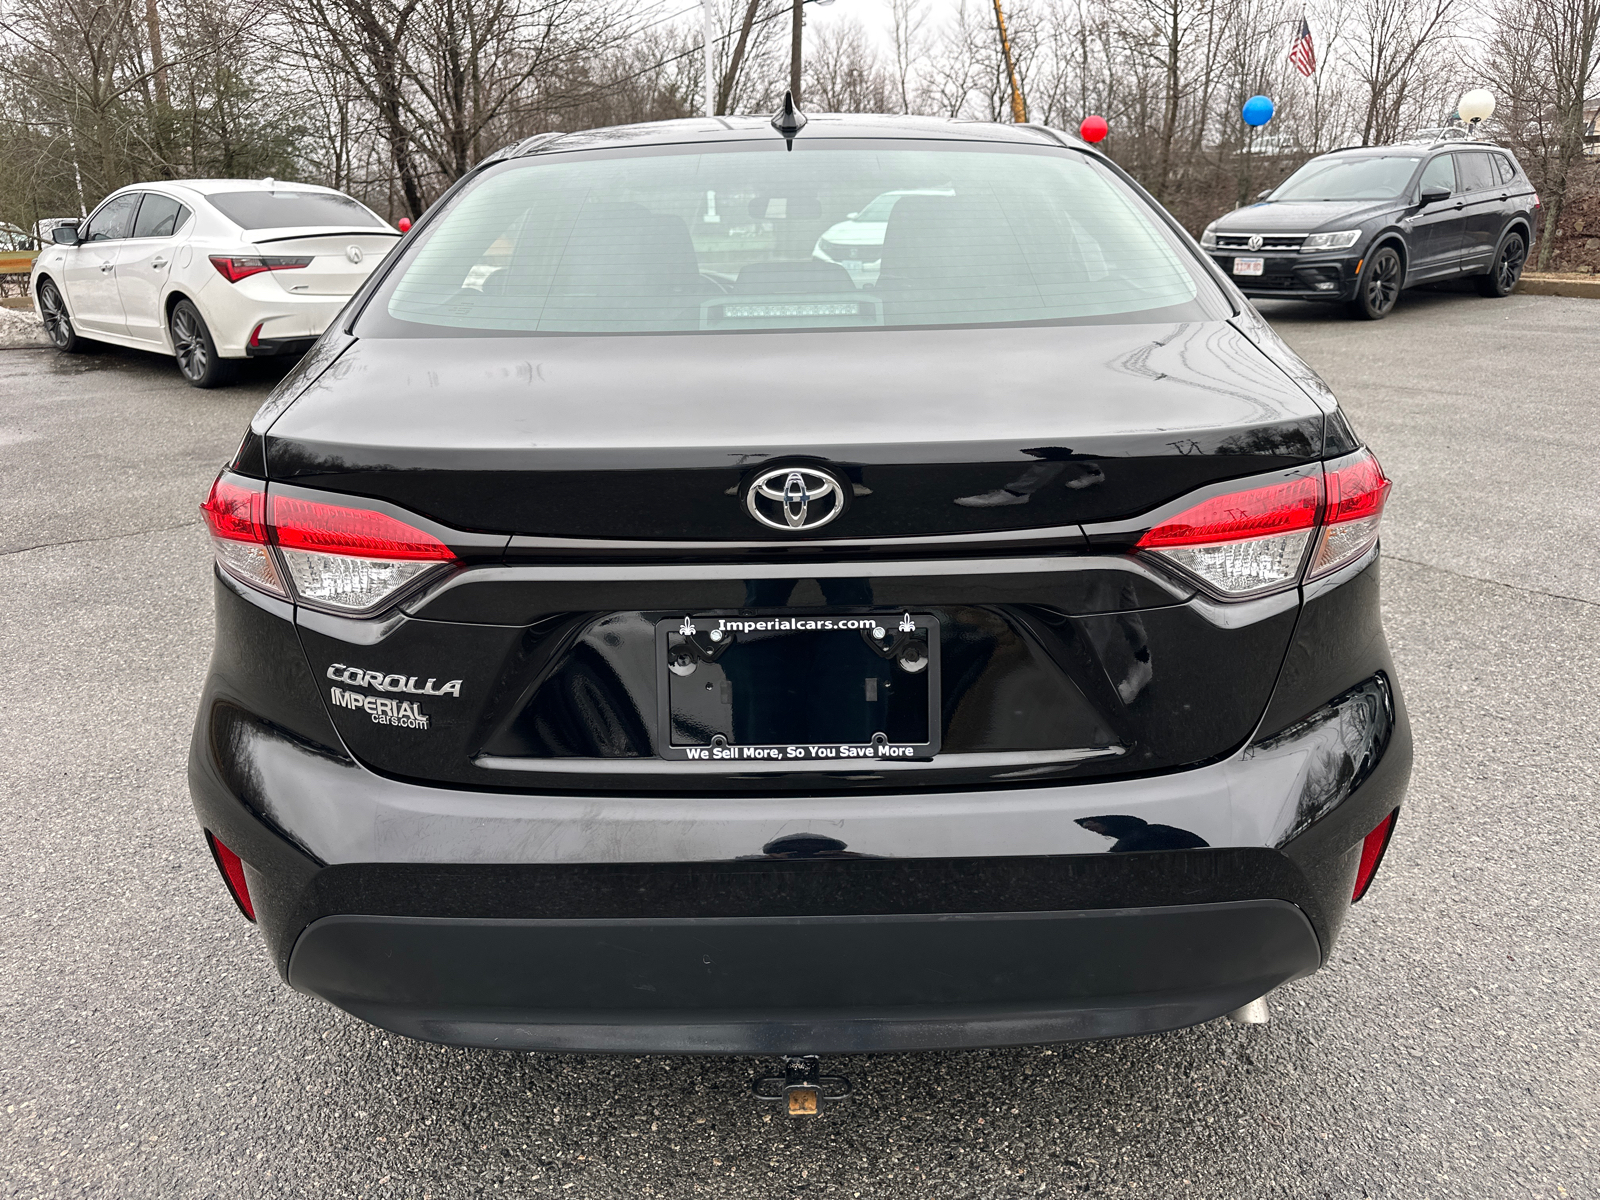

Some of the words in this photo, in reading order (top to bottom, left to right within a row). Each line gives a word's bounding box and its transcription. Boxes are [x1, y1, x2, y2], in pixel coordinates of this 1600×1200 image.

[718, 618, 876, 633] Imperialcars.com
[326, 663, 463, 697] COROLLA
[330, 687, 430, 721] IMPERIAL
[371, 713, 430, 730] cars.com
[686, 748, 711, 760] We
[712, 747, 739, 759] Sell
[743, 747, 783, 760] More,
[786, 746, 805, 758] So
[809, 746, 836, 757] You
[840, 746, 875, 757] Save
[879, 745, 914, 756] More
